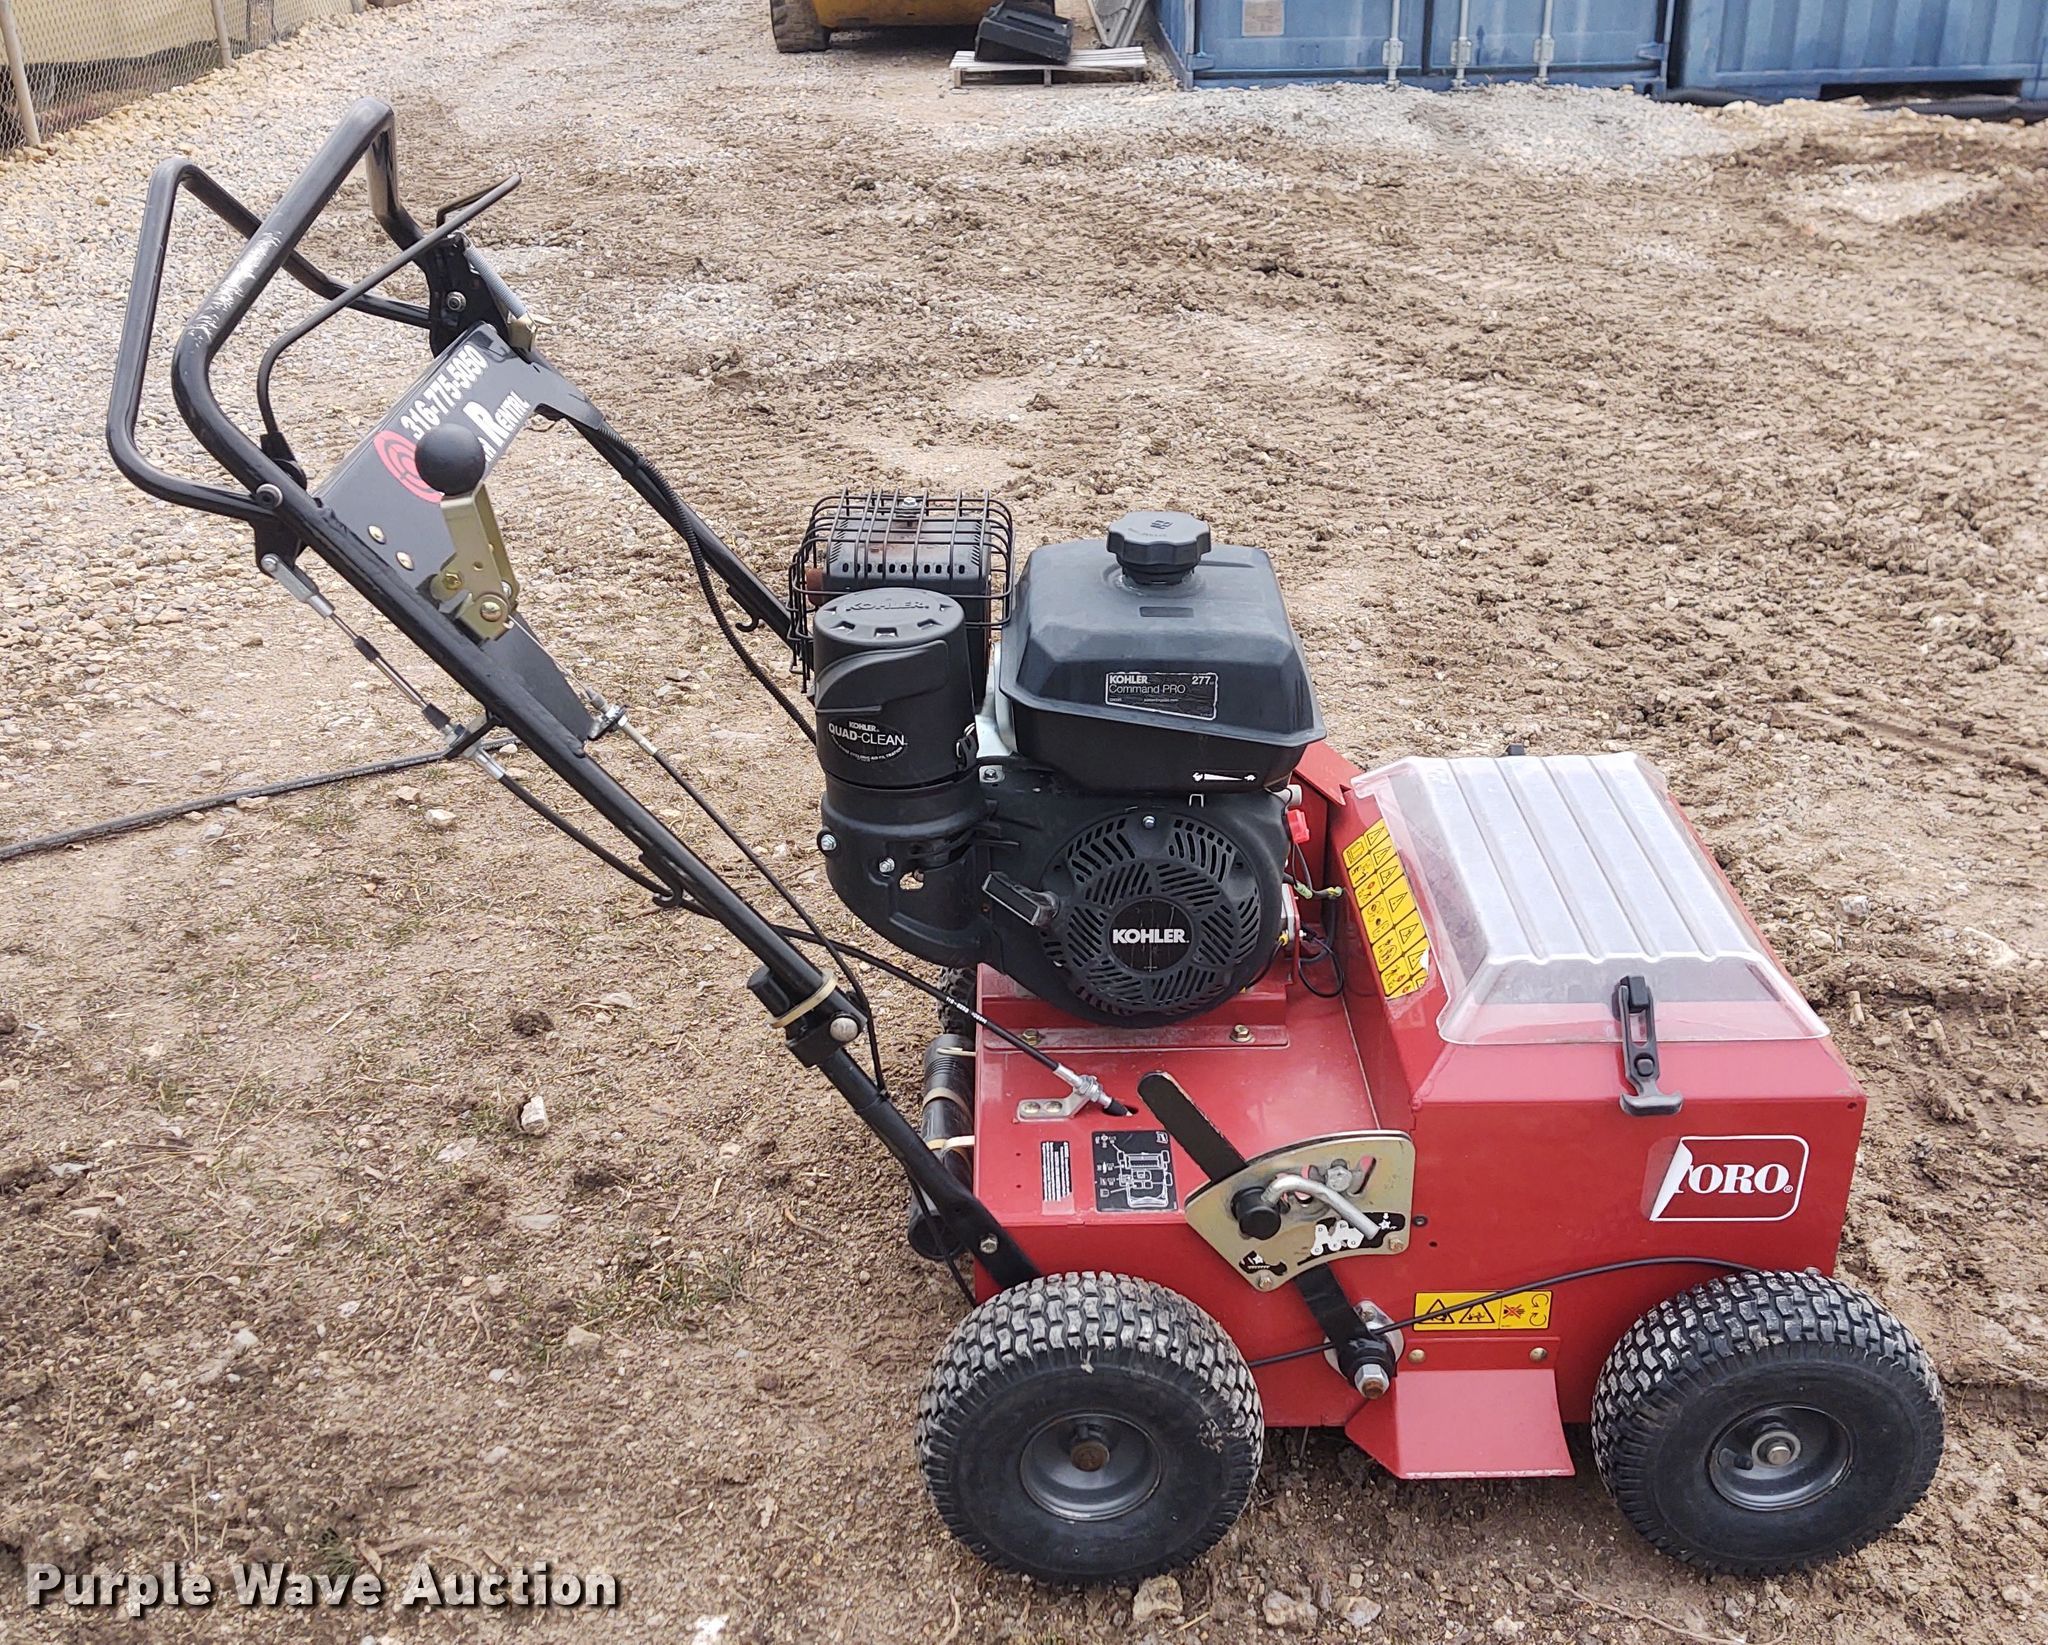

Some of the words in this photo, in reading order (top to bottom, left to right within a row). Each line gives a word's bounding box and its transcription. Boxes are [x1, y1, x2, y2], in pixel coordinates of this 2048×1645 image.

[400, 344, 488, 440] 316-775-5050
[1109, 675, 1148, 684] KOHLER
[1192, 676, 1211, 685] 277
[1109, 684, 1160, 694] Command
[1162, 684, 1186, 694] PRO
[828, 722, 905, 746] QUAD-CLEAN
[849, 721, 877, 732] KOHLER
[1112, 928, 1186, 944] KOHLER
[1675, 1163, 1790, 1194] ORO
